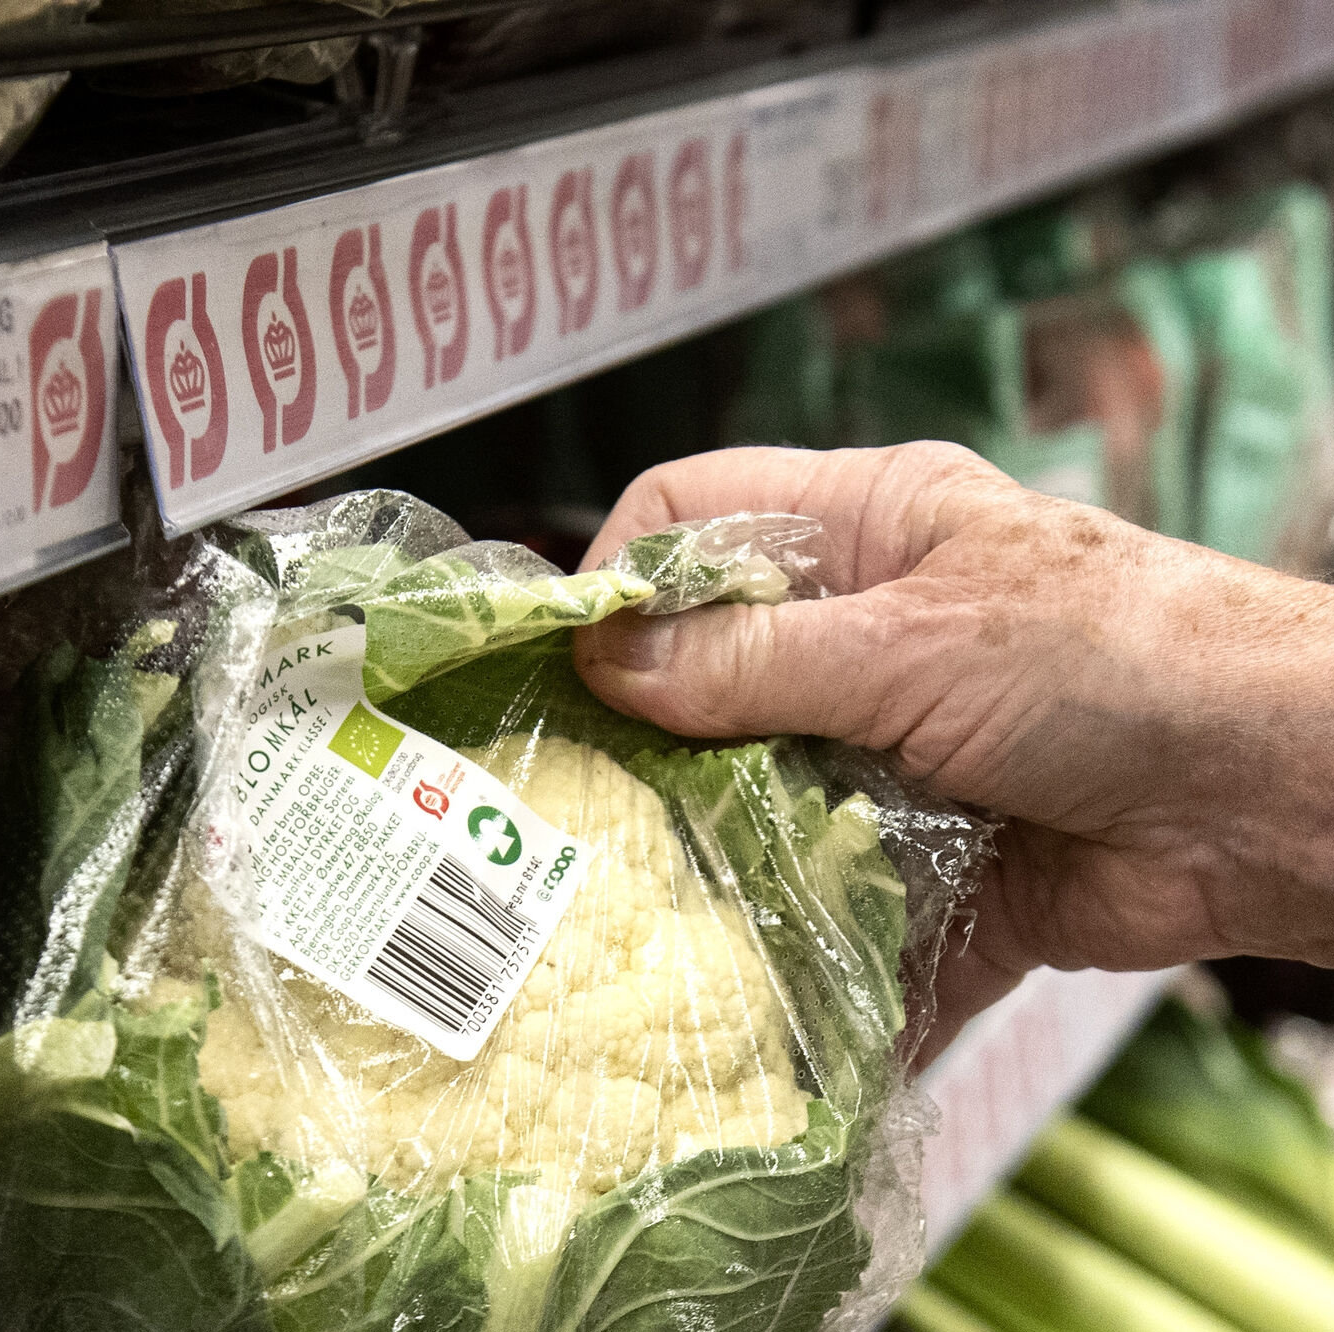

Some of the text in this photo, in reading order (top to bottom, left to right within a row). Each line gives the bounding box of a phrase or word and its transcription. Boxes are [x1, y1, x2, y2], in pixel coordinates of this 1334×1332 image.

[232, 687, 317, 803] BLOMKÅL
[250, 757, 301, 826] DANMARK
[299, 716, 327, 752] KLASSE
[263, 829, 279, 846] før
[275, 801, 302, 829] brug.
[299, 765, 323, 796] OPBE-
[269, 837, 293, 866] HOS
[273, 814, 327, 887] EMBALLAGE:
[282, 795, 359, 906] estaffald. DYRKET OG
[274, 898, 306, 938] PKKET
[316, 828, 360, 880] Østerkrog
[289, 823, 377, 948] ApS, Tingstedvej 47, 8850
[300, 813, 402, 956] Bjerringbro, Danmark. PAKKET
[326, 831, 428, 973] DK-2620 Albertslund FORBRU-
[330, 917, 352, 941] Coop
[346, 874, 381, 917] Danmark
[377, 852, 398, 875] A/S,
[340, 842, 439, 981] GERKONTAKT: www.coop.dk
[461, 927, 539, 1034] 700381 757511
